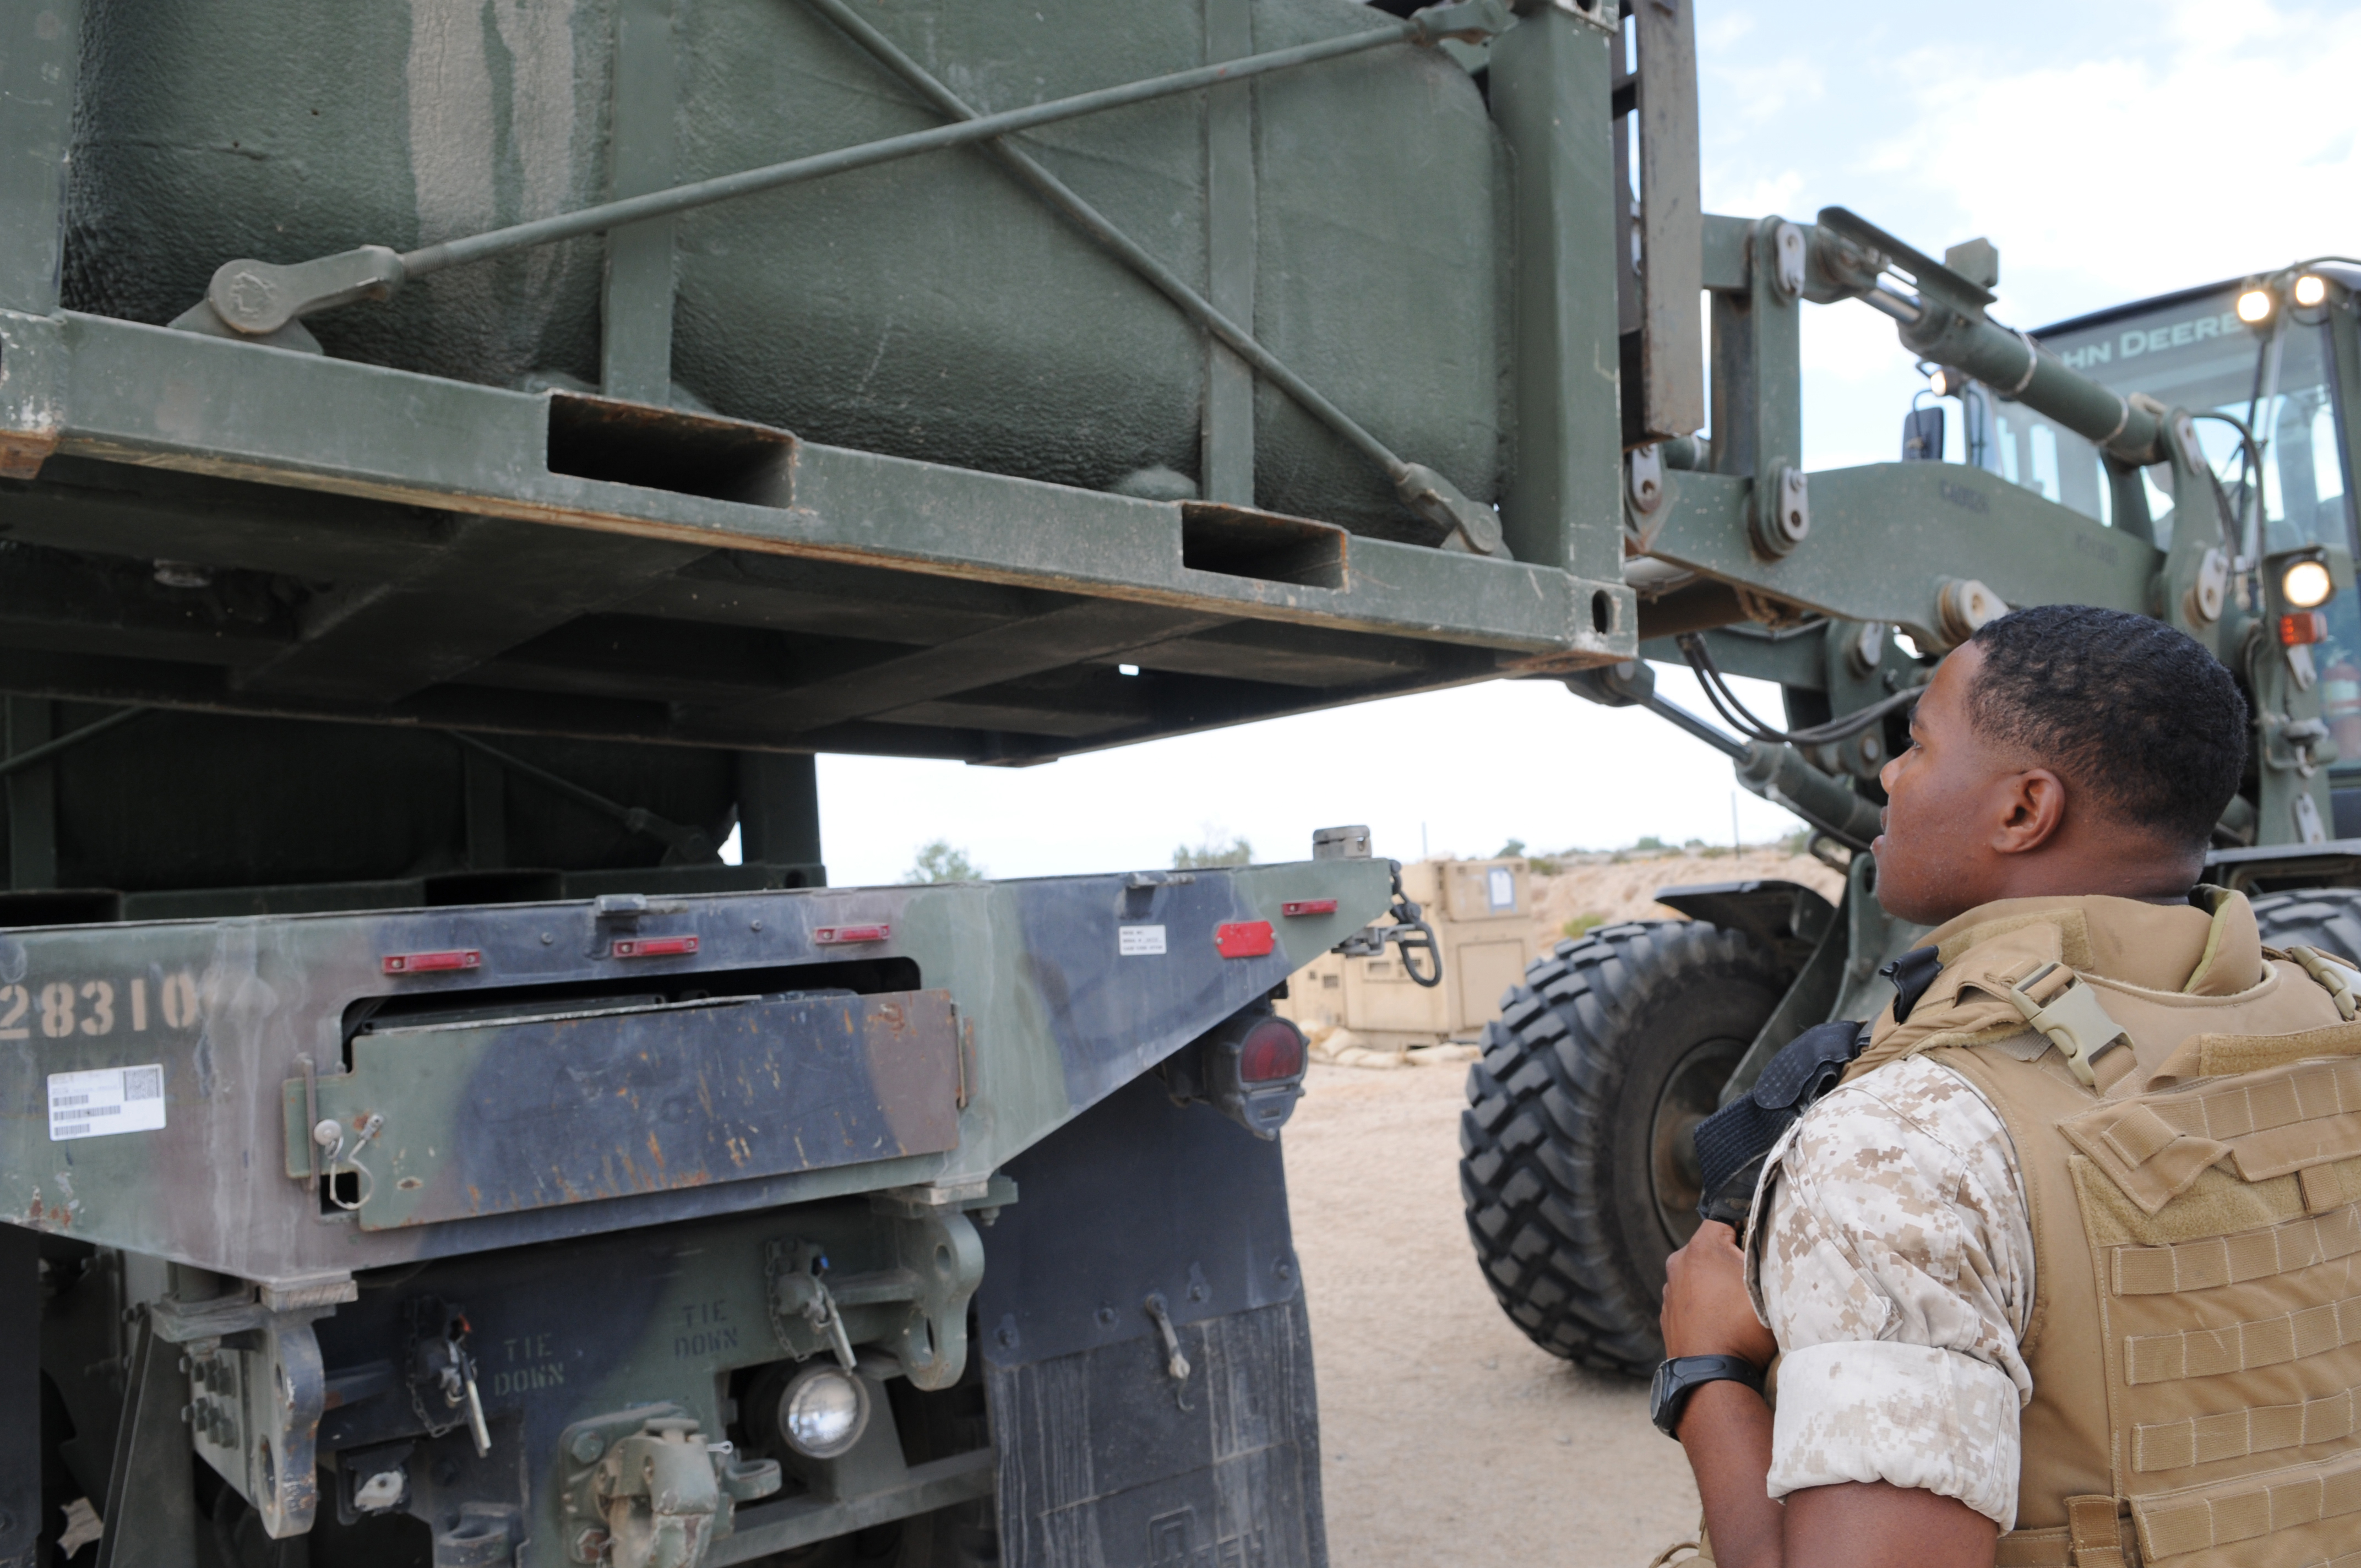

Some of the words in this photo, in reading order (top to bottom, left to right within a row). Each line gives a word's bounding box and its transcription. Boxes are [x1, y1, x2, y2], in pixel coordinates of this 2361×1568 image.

[2061, 343, 2112, 368] HN
[2121, 312, 2244, 358] DEERE
[0, 974, 196, 1039] 28310
[682, 1299, 727, 1328] TIE
[503, 1333, 553, 1362] TIE
[674, 1327, 738, 1359] DOWN
[494, 1362, 565, 1397] DOWN
